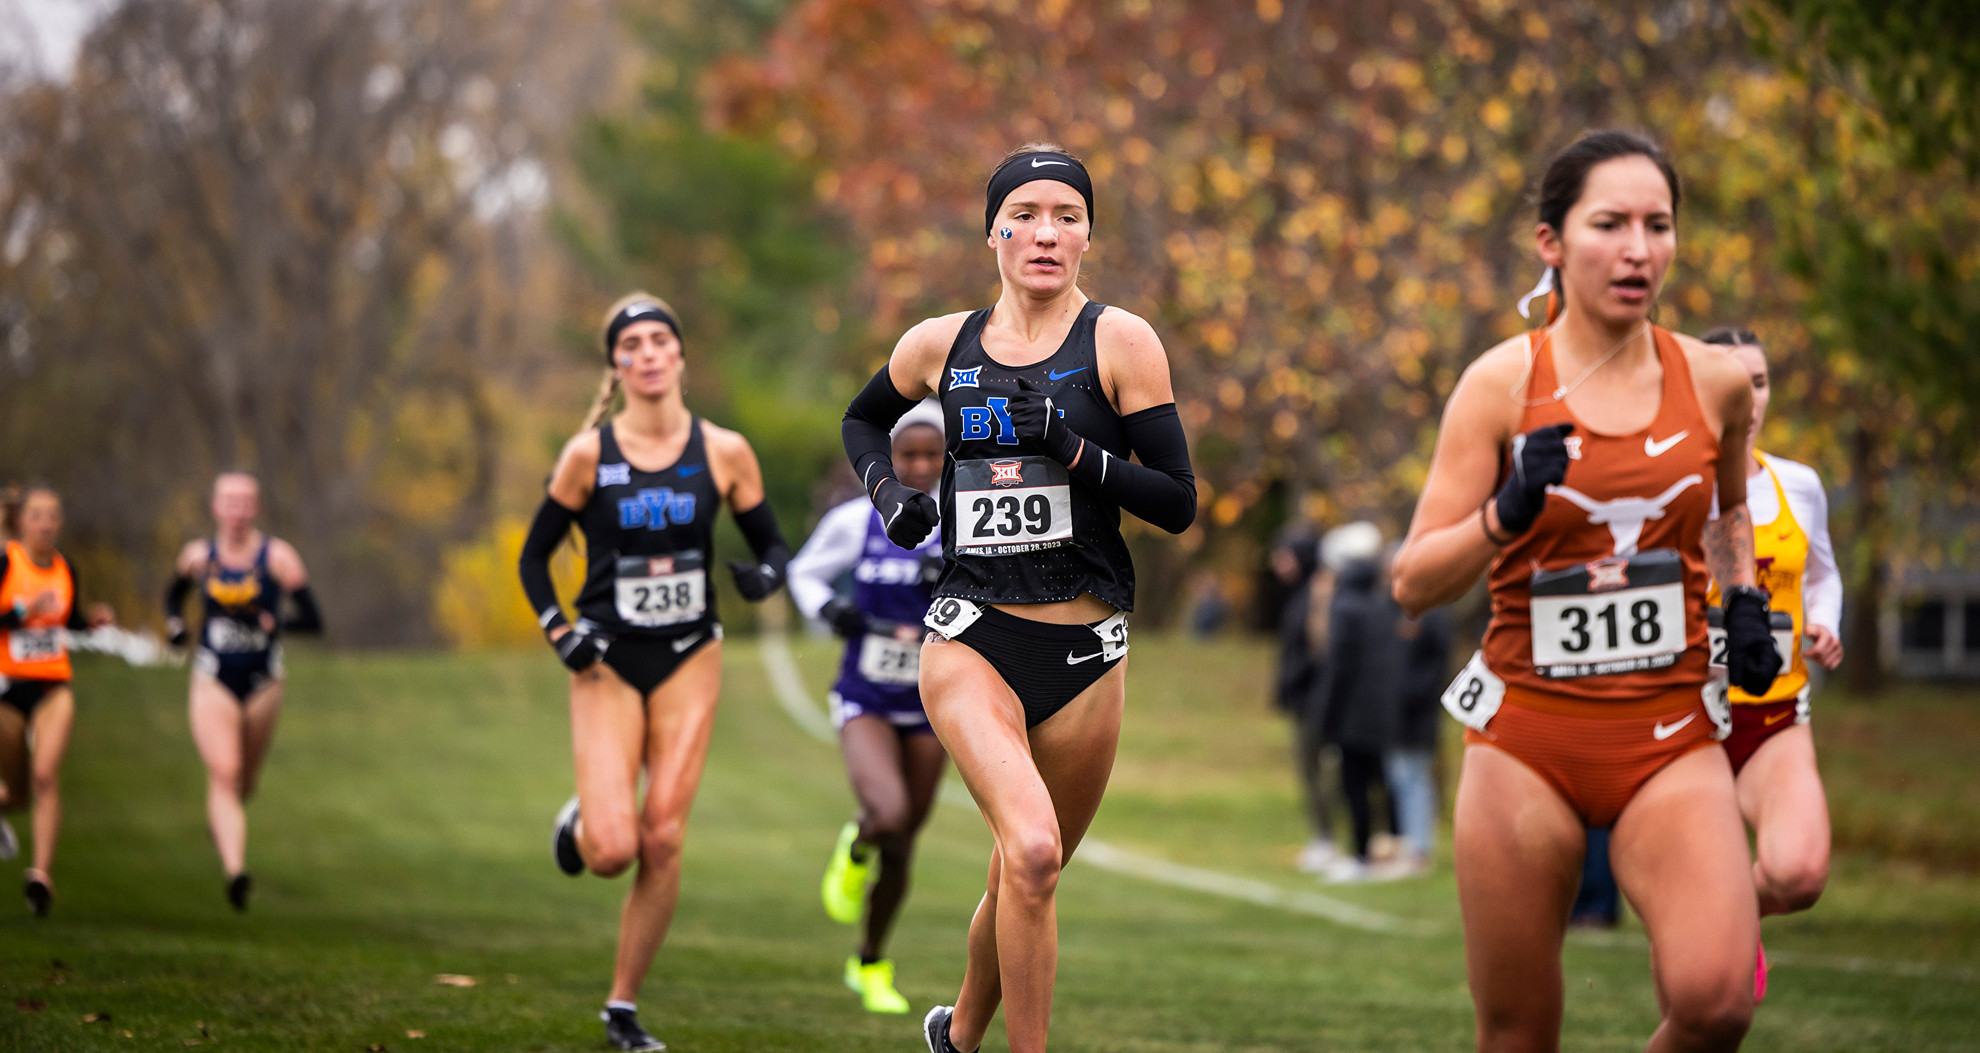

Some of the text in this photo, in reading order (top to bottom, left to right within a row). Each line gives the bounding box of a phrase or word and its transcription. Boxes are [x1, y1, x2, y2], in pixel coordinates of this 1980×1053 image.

[960, 397, 1064, 445] BY
[617, 487, 697, 530] BYU
[972, 494, 1051, 538] 239
[985, 546, 993, 554] IA
[997, 543, 1030, 554] OCTOBER
[1042, 540, 1062, 550] 2023
[634, 582, 691, 613] 238
[1559, 600, 1662, 653] 318
